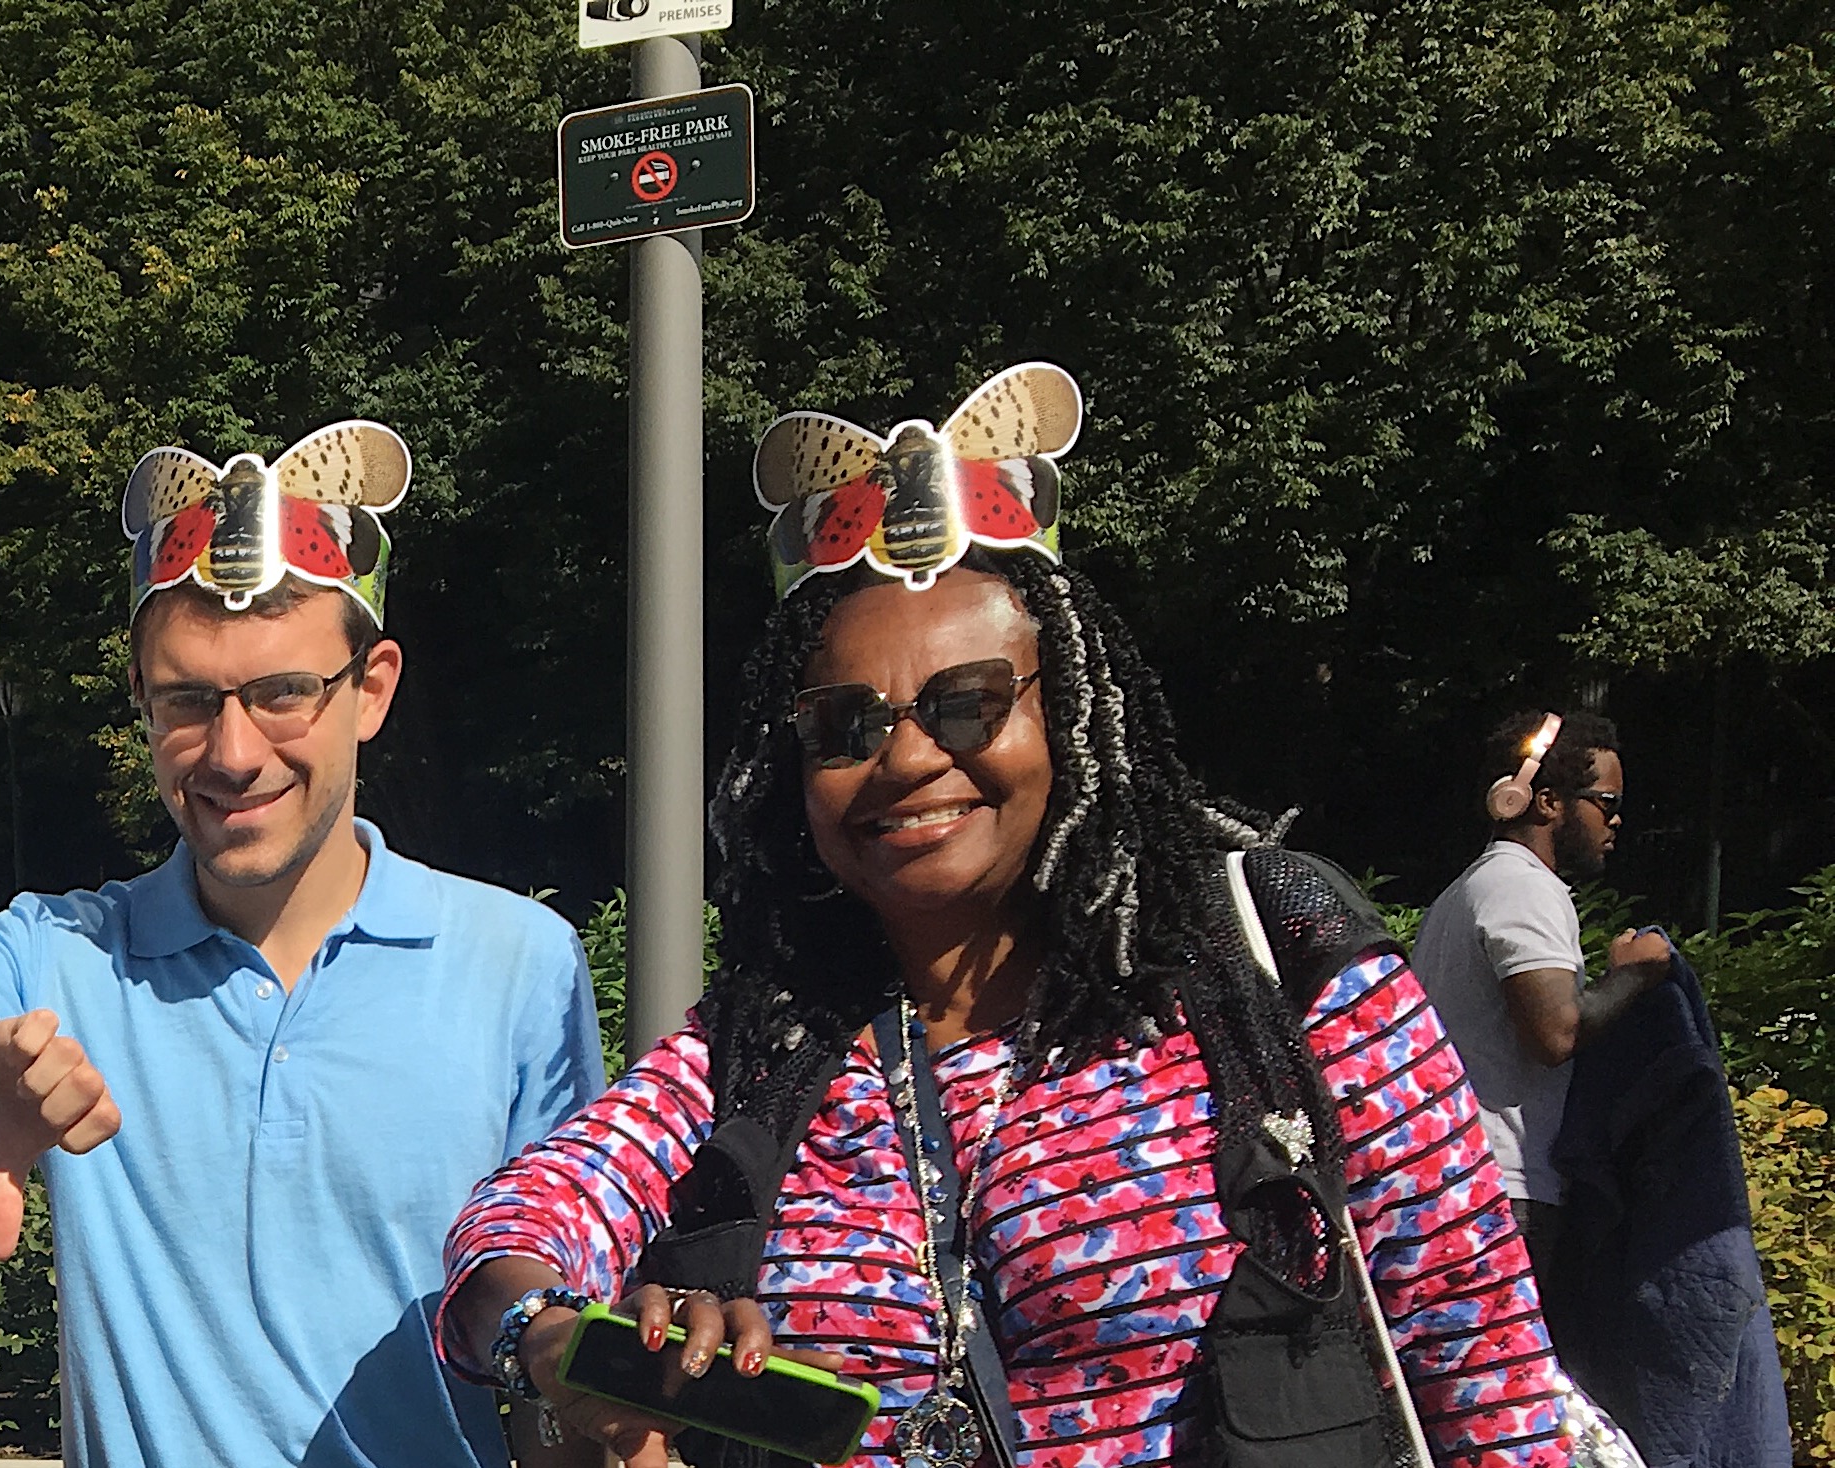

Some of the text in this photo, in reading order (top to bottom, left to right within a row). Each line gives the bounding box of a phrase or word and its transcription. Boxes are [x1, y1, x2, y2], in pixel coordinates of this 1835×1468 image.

[659, 4, 722, 22] PREMISES
[581, 115, 729, 154] SMOKE-FREE PARK
